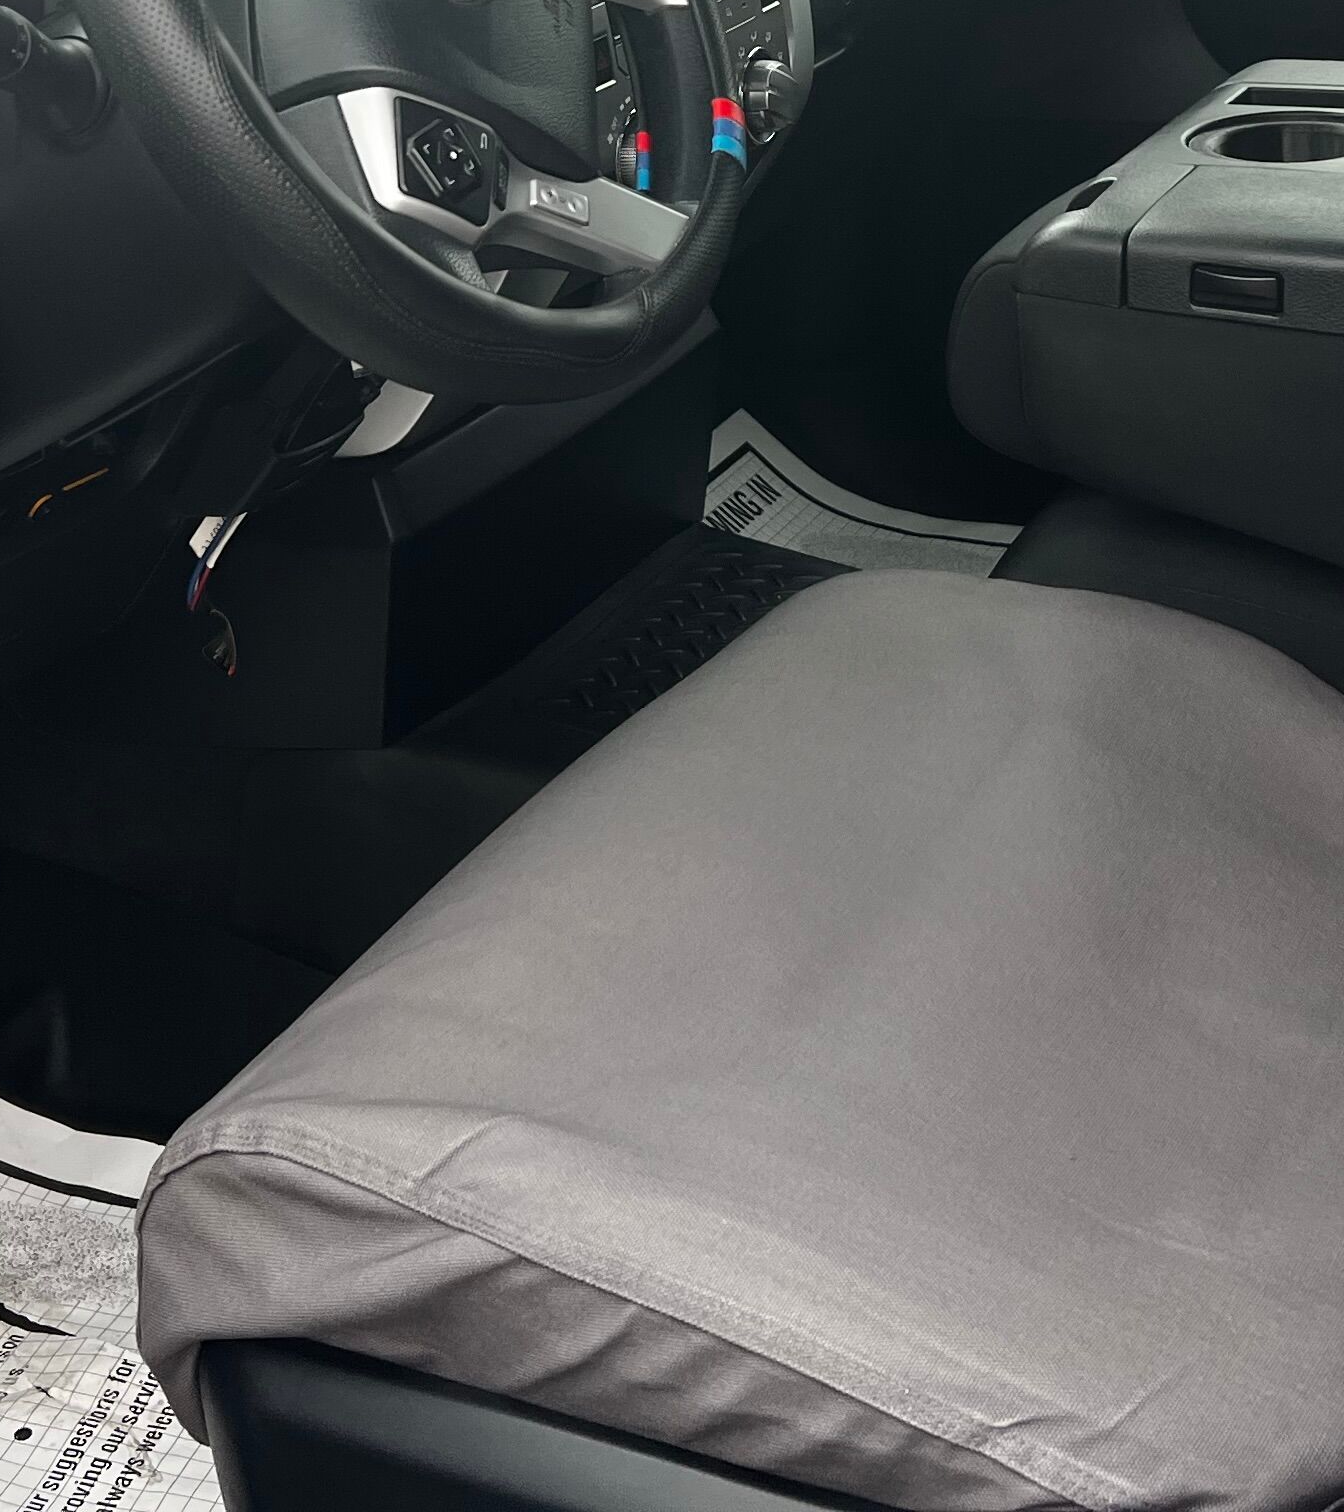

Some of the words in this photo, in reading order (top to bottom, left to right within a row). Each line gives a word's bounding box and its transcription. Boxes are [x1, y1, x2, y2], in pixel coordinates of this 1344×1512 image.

[746, 473, 783, 506] IN
[42, 1387, 120, 1492] suggestions
[106, 1358, 137, 1384] for
[101, 1426, 129, 1454] our
